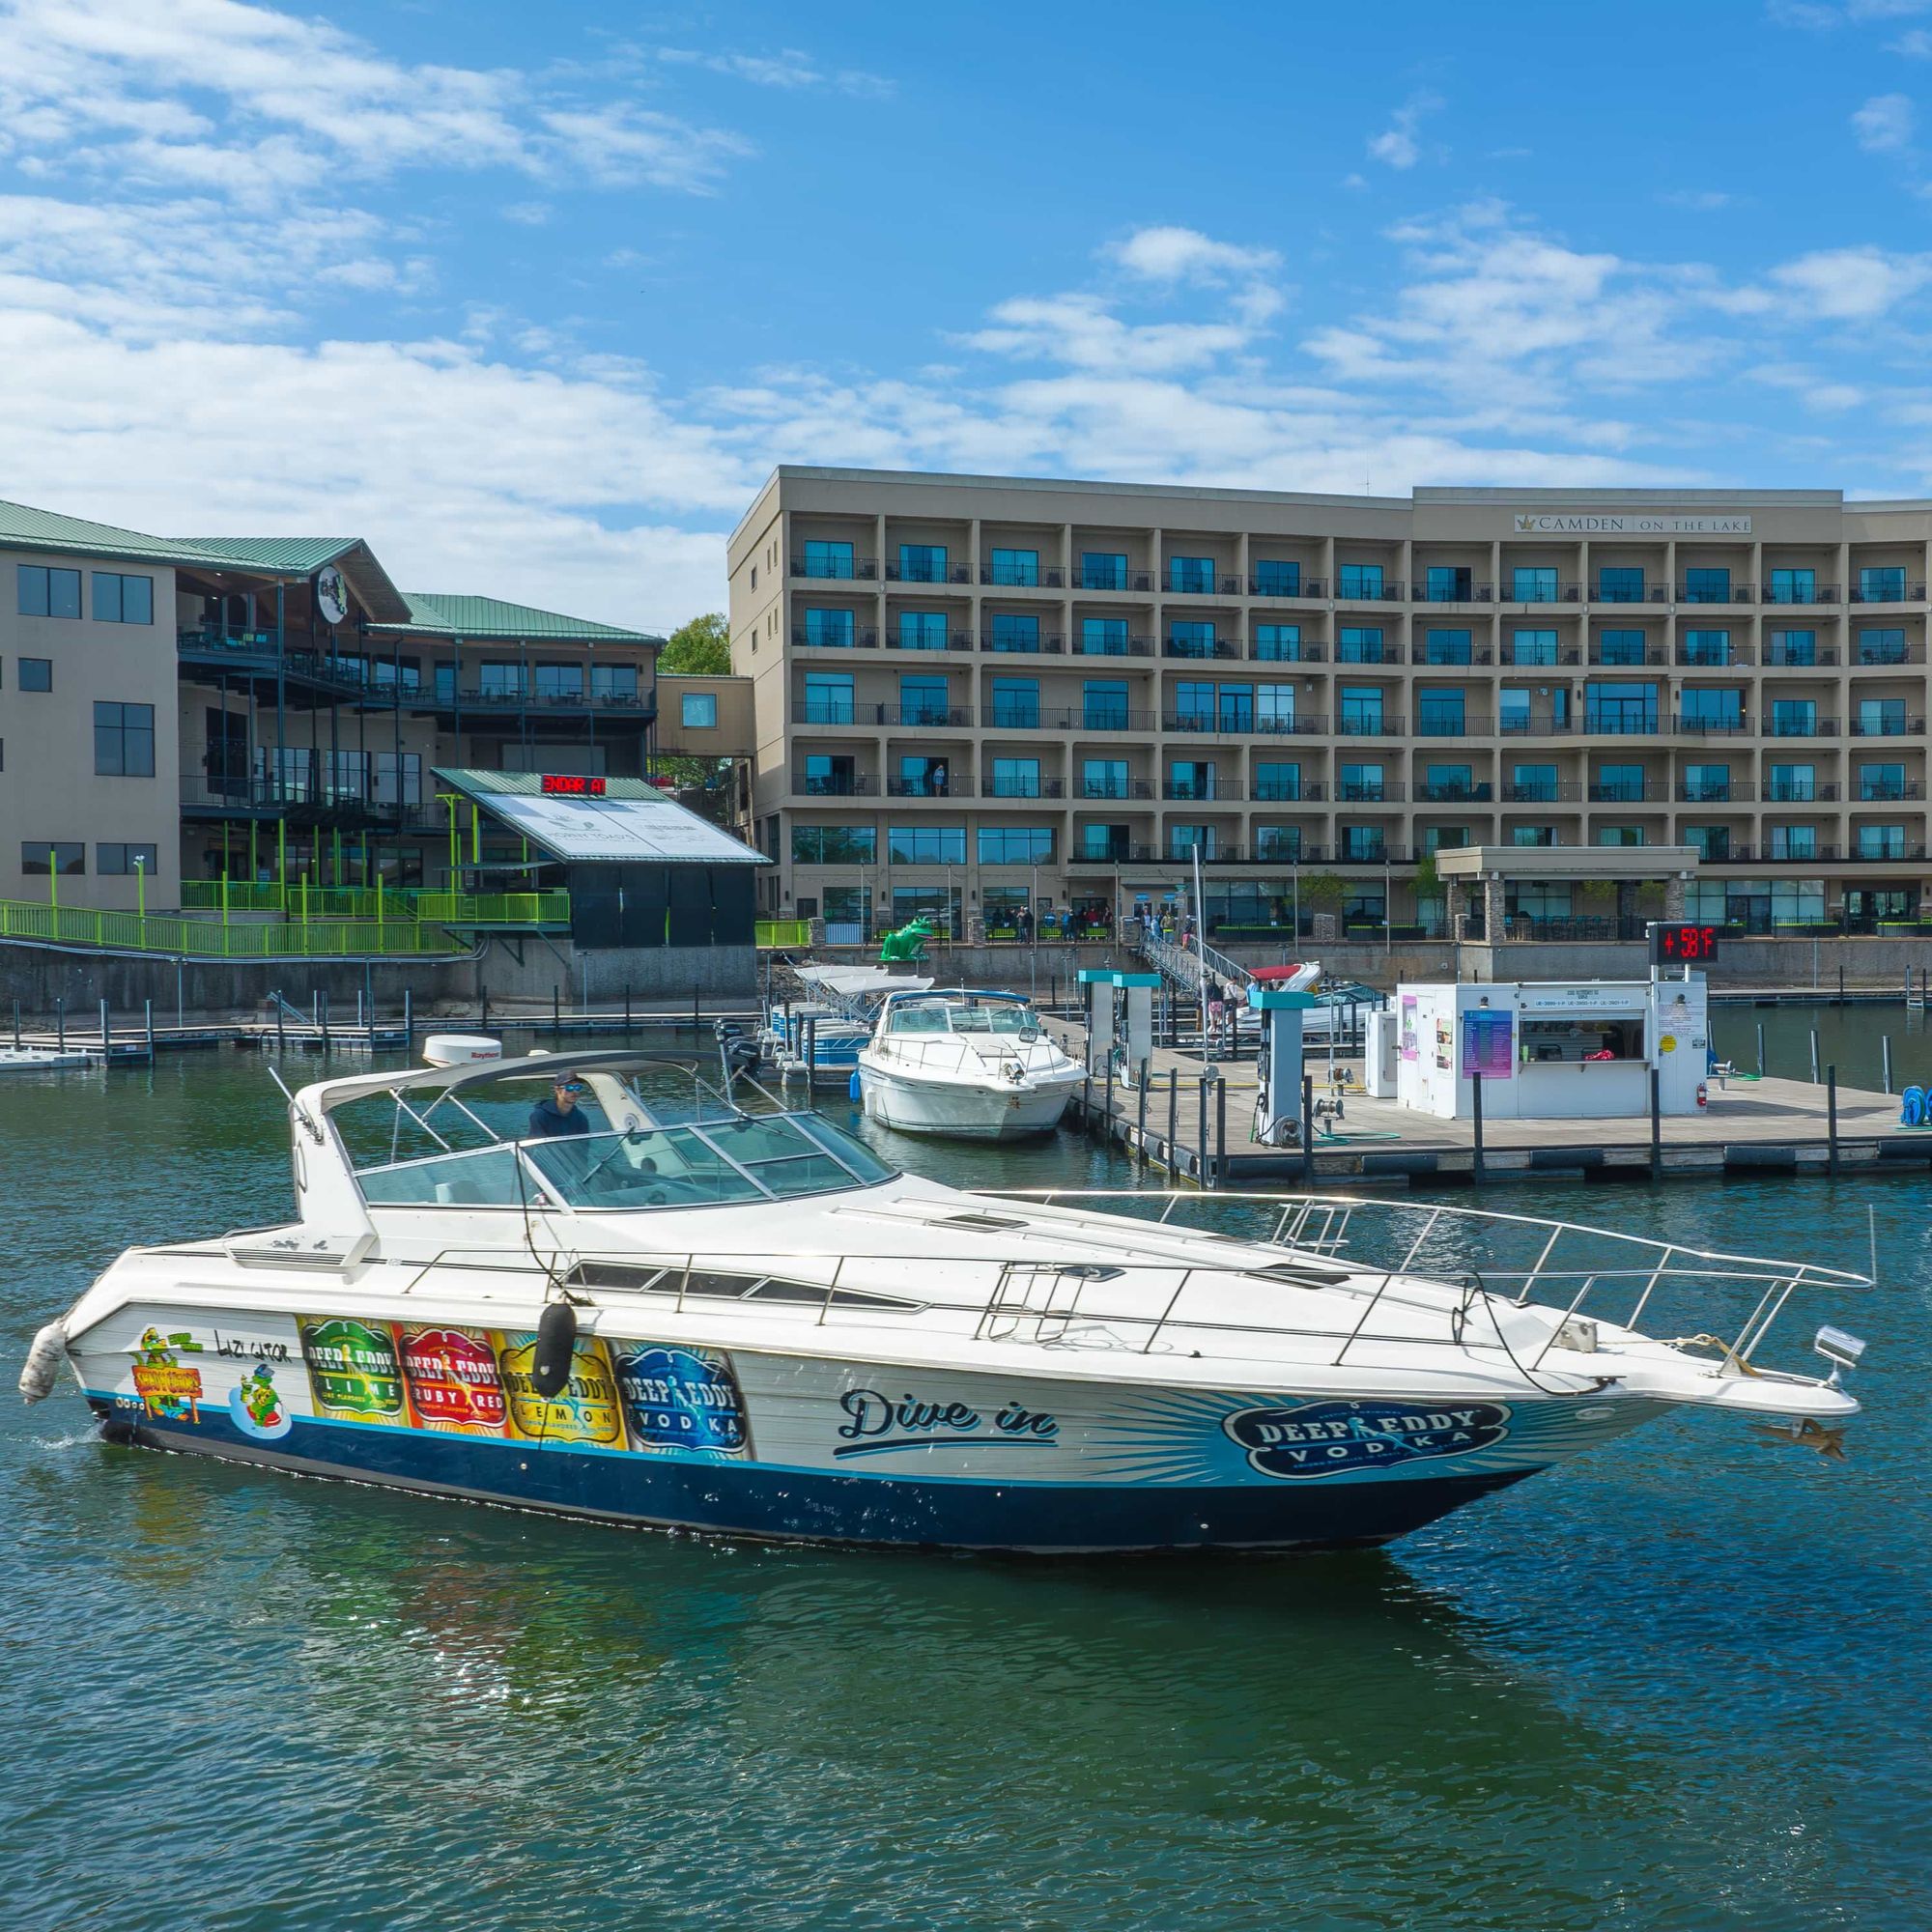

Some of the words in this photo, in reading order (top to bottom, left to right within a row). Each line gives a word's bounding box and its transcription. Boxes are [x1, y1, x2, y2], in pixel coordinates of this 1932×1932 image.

[1538, 517, 1624, 530] CAMDEN
[1639, 521, 1664, 530] ON
[1672, 521, 1704, 530] THE
[1713, 521, 1750, 531] LAKE
[308, 1346, 344, 1371] DEEP
[355, 1350, 395, 1376] EDDY
[406, 1354, 442, 1381] DEEP
[456, 1359, 498, 1385] EDDY
[326, 1378, 395, 1397] LIME
[414, 1387, 457, 1405] RUBY
[477, 1393, 503, 1409] RED
[622, 1376, 669, 1404] DEEP
[683, 1380, 737, 1408] EDDY
[520, 1406, 611, 1424] LEMON
[639, 1411, 738, 1433] VODKA
[838, 1388, 981, 1440] Dive
[995, 1401, 1060, 1438] in
[1256, 1421, 1350, 1443] DEEP
[1378, 1409, 1477, 1434] EDDY
[1289, 1430, 1472, 1463] VODKA
